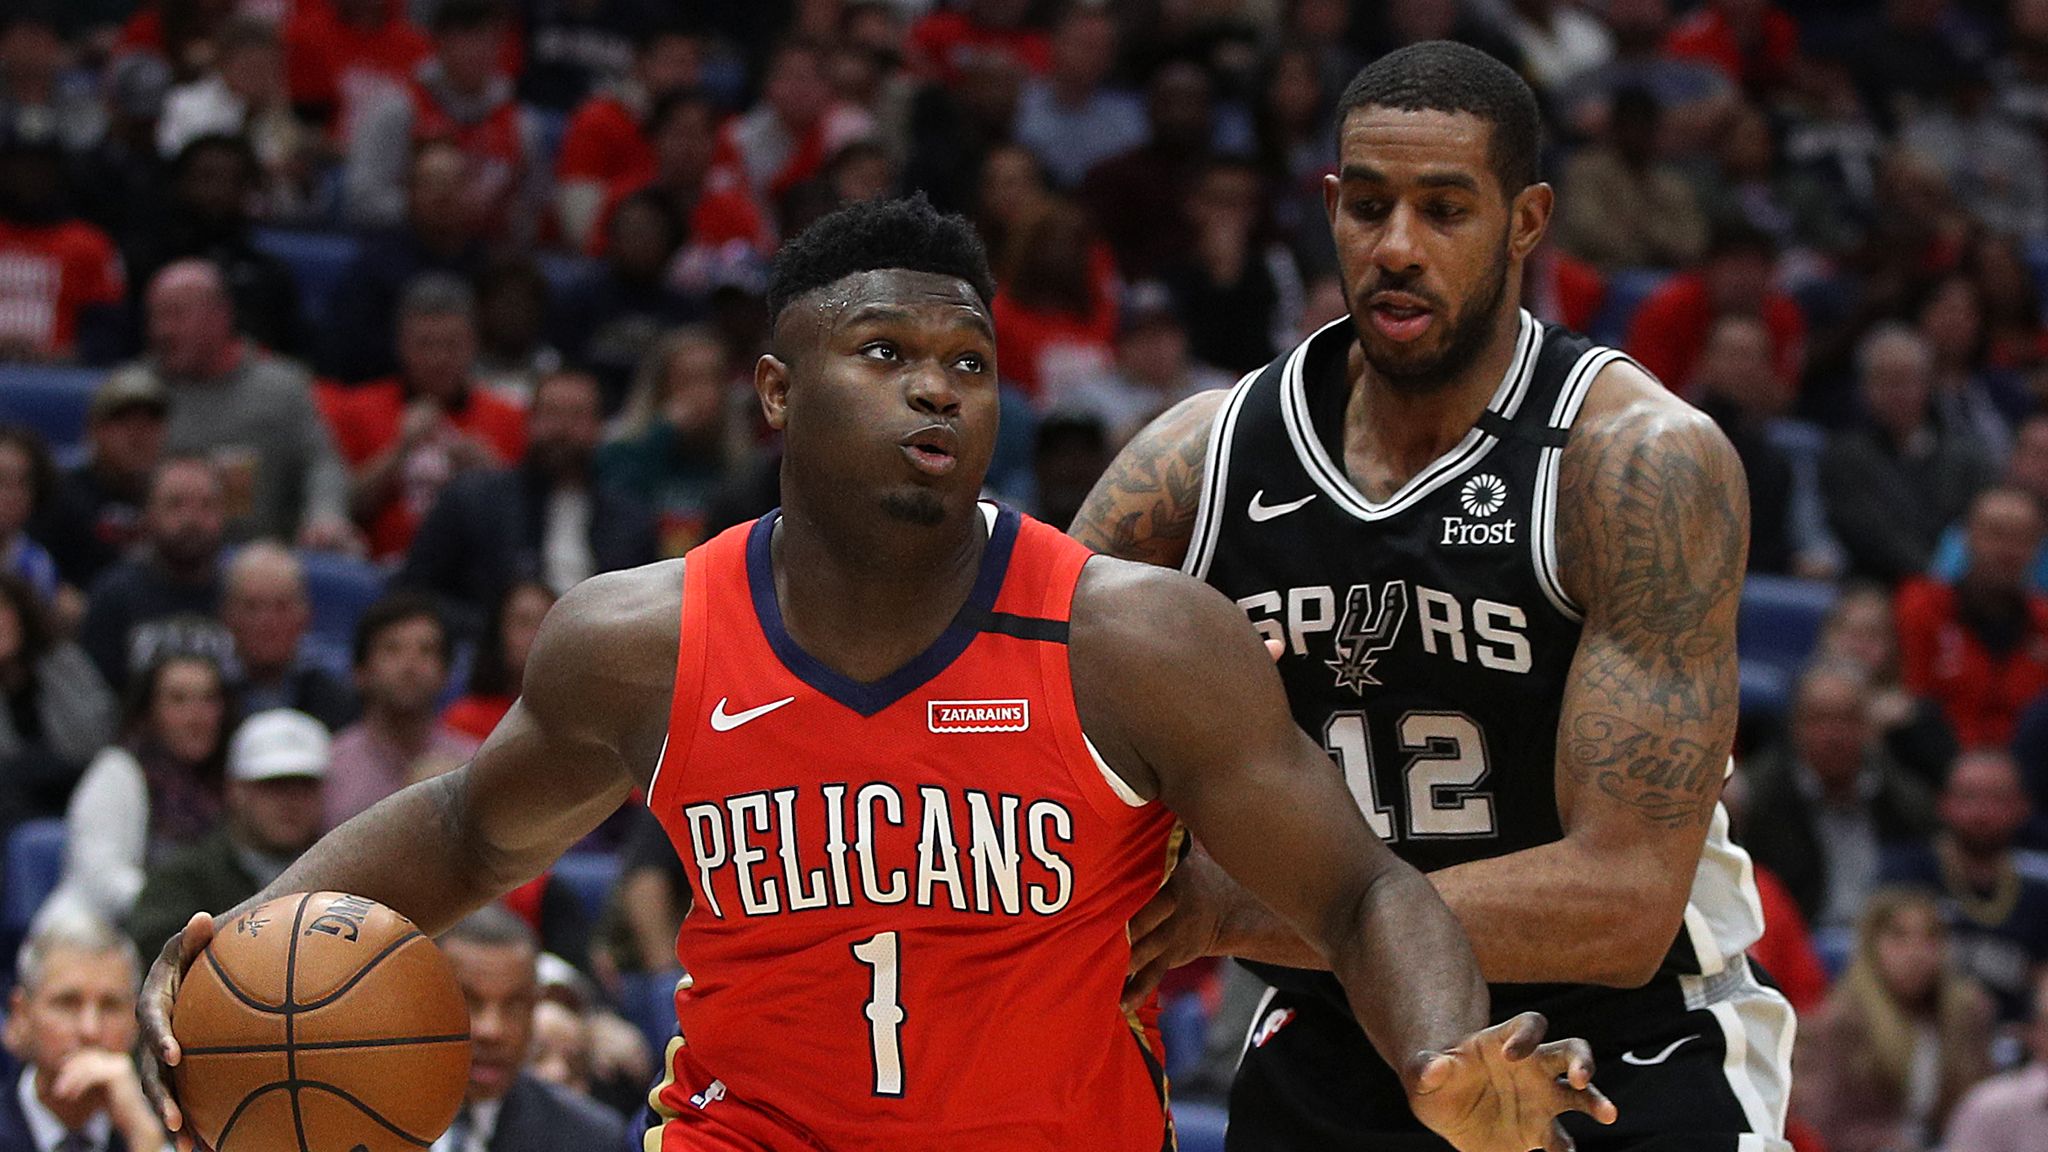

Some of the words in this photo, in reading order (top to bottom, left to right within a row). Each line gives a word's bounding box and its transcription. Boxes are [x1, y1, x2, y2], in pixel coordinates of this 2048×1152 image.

[1440, 516, 1517, 545] Frost
[1236, 580, 1534, 696] SPURS
[940, 707, 1023, 722] ZATARAIN'S
[1322, 709, 1499, 844] 12
[682, 781, 1077, 920] PELICANS
[848, 930, 908, 1099] 1
